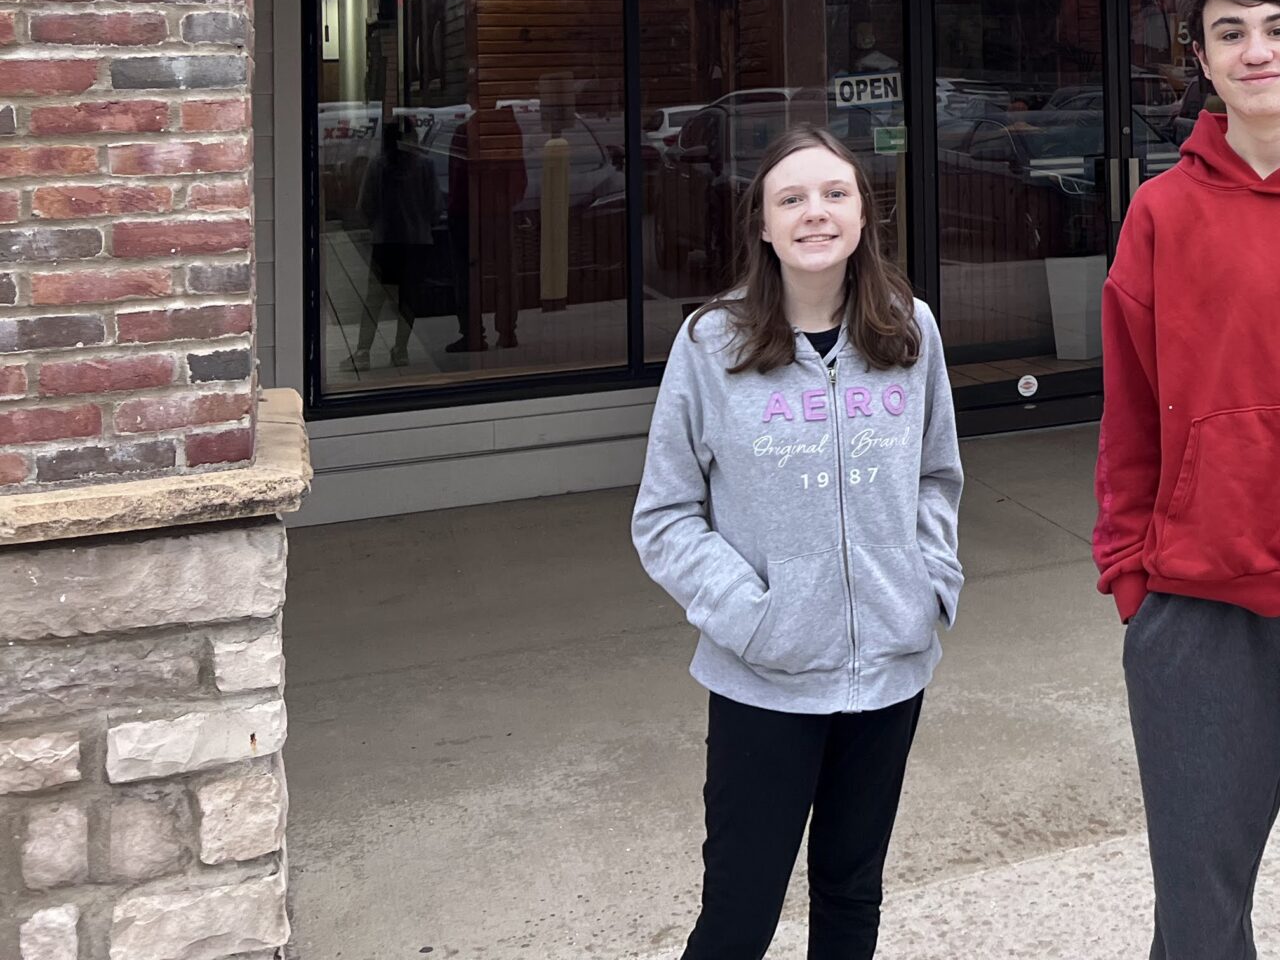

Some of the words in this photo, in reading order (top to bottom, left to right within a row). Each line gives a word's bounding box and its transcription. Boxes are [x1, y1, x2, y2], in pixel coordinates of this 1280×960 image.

[839, 77, 899, 102] OPEN
[762, 384, 907, 423] AERO
[752, 434, 831, 468] Original
[850, 426, 911, 458] Brand
